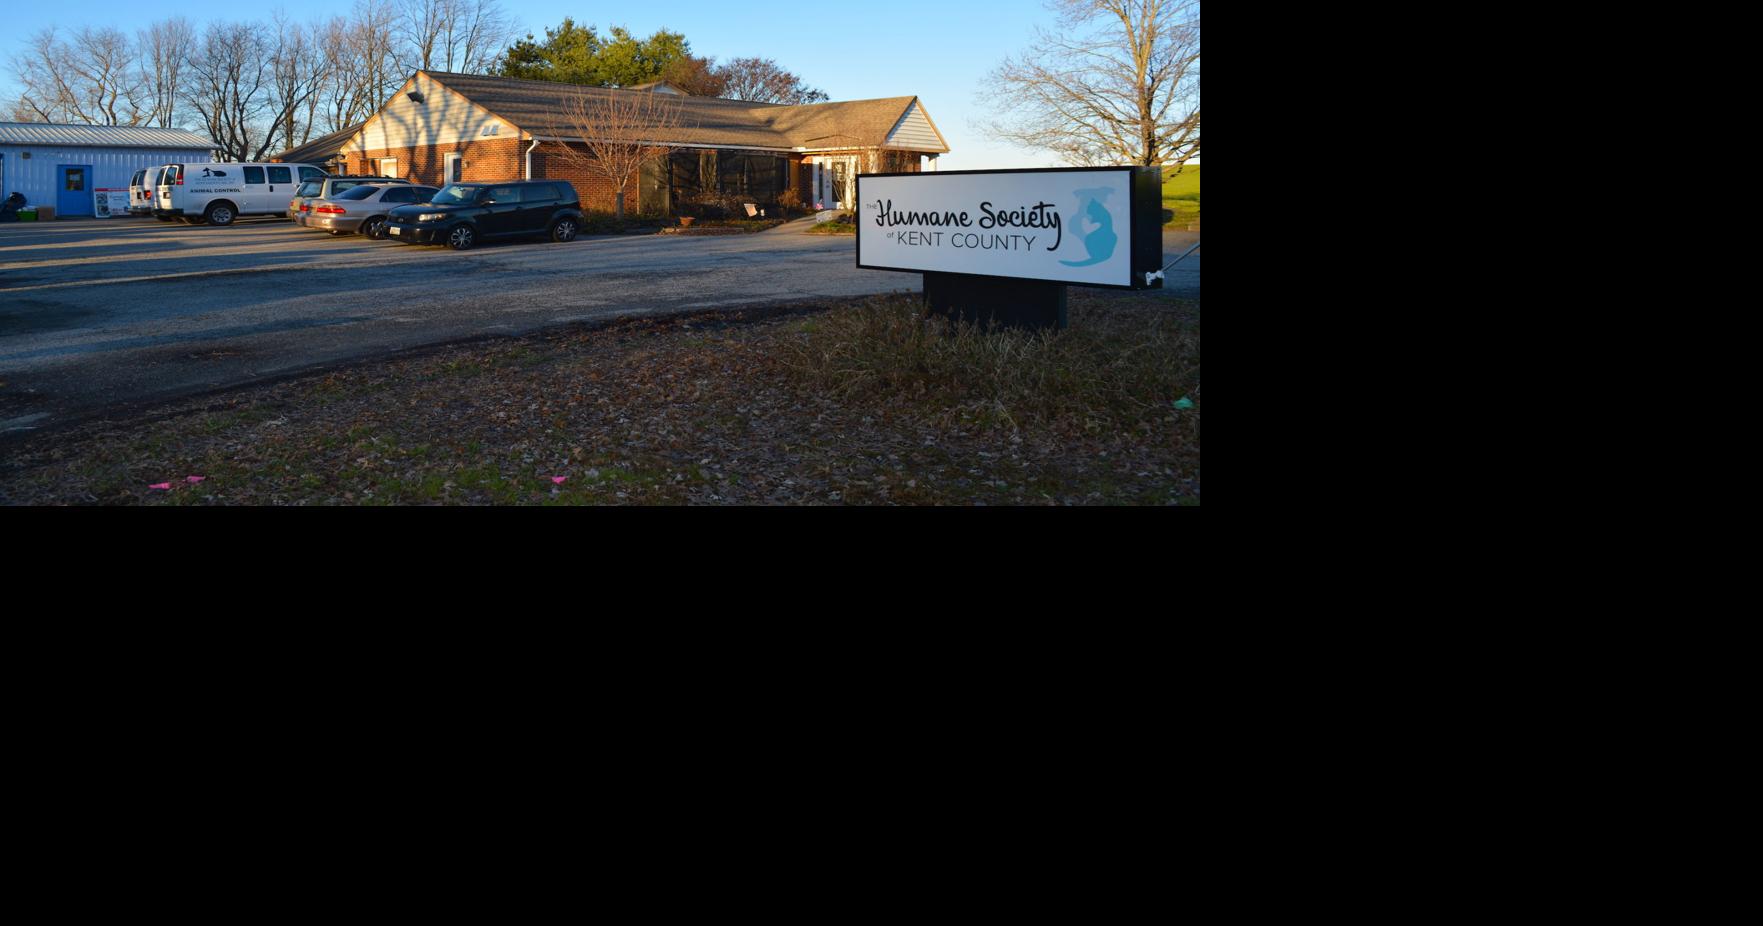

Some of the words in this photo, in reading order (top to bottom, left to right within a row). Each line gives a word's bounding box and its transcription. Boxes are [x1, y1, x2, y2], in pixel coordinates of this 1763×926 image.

[875, 199, 973, 227] Humane
[978, 201, 1062, 252] Society
[897, 231, 944, 247] KENT
[951, 232, 1036, 252] COUNTY
